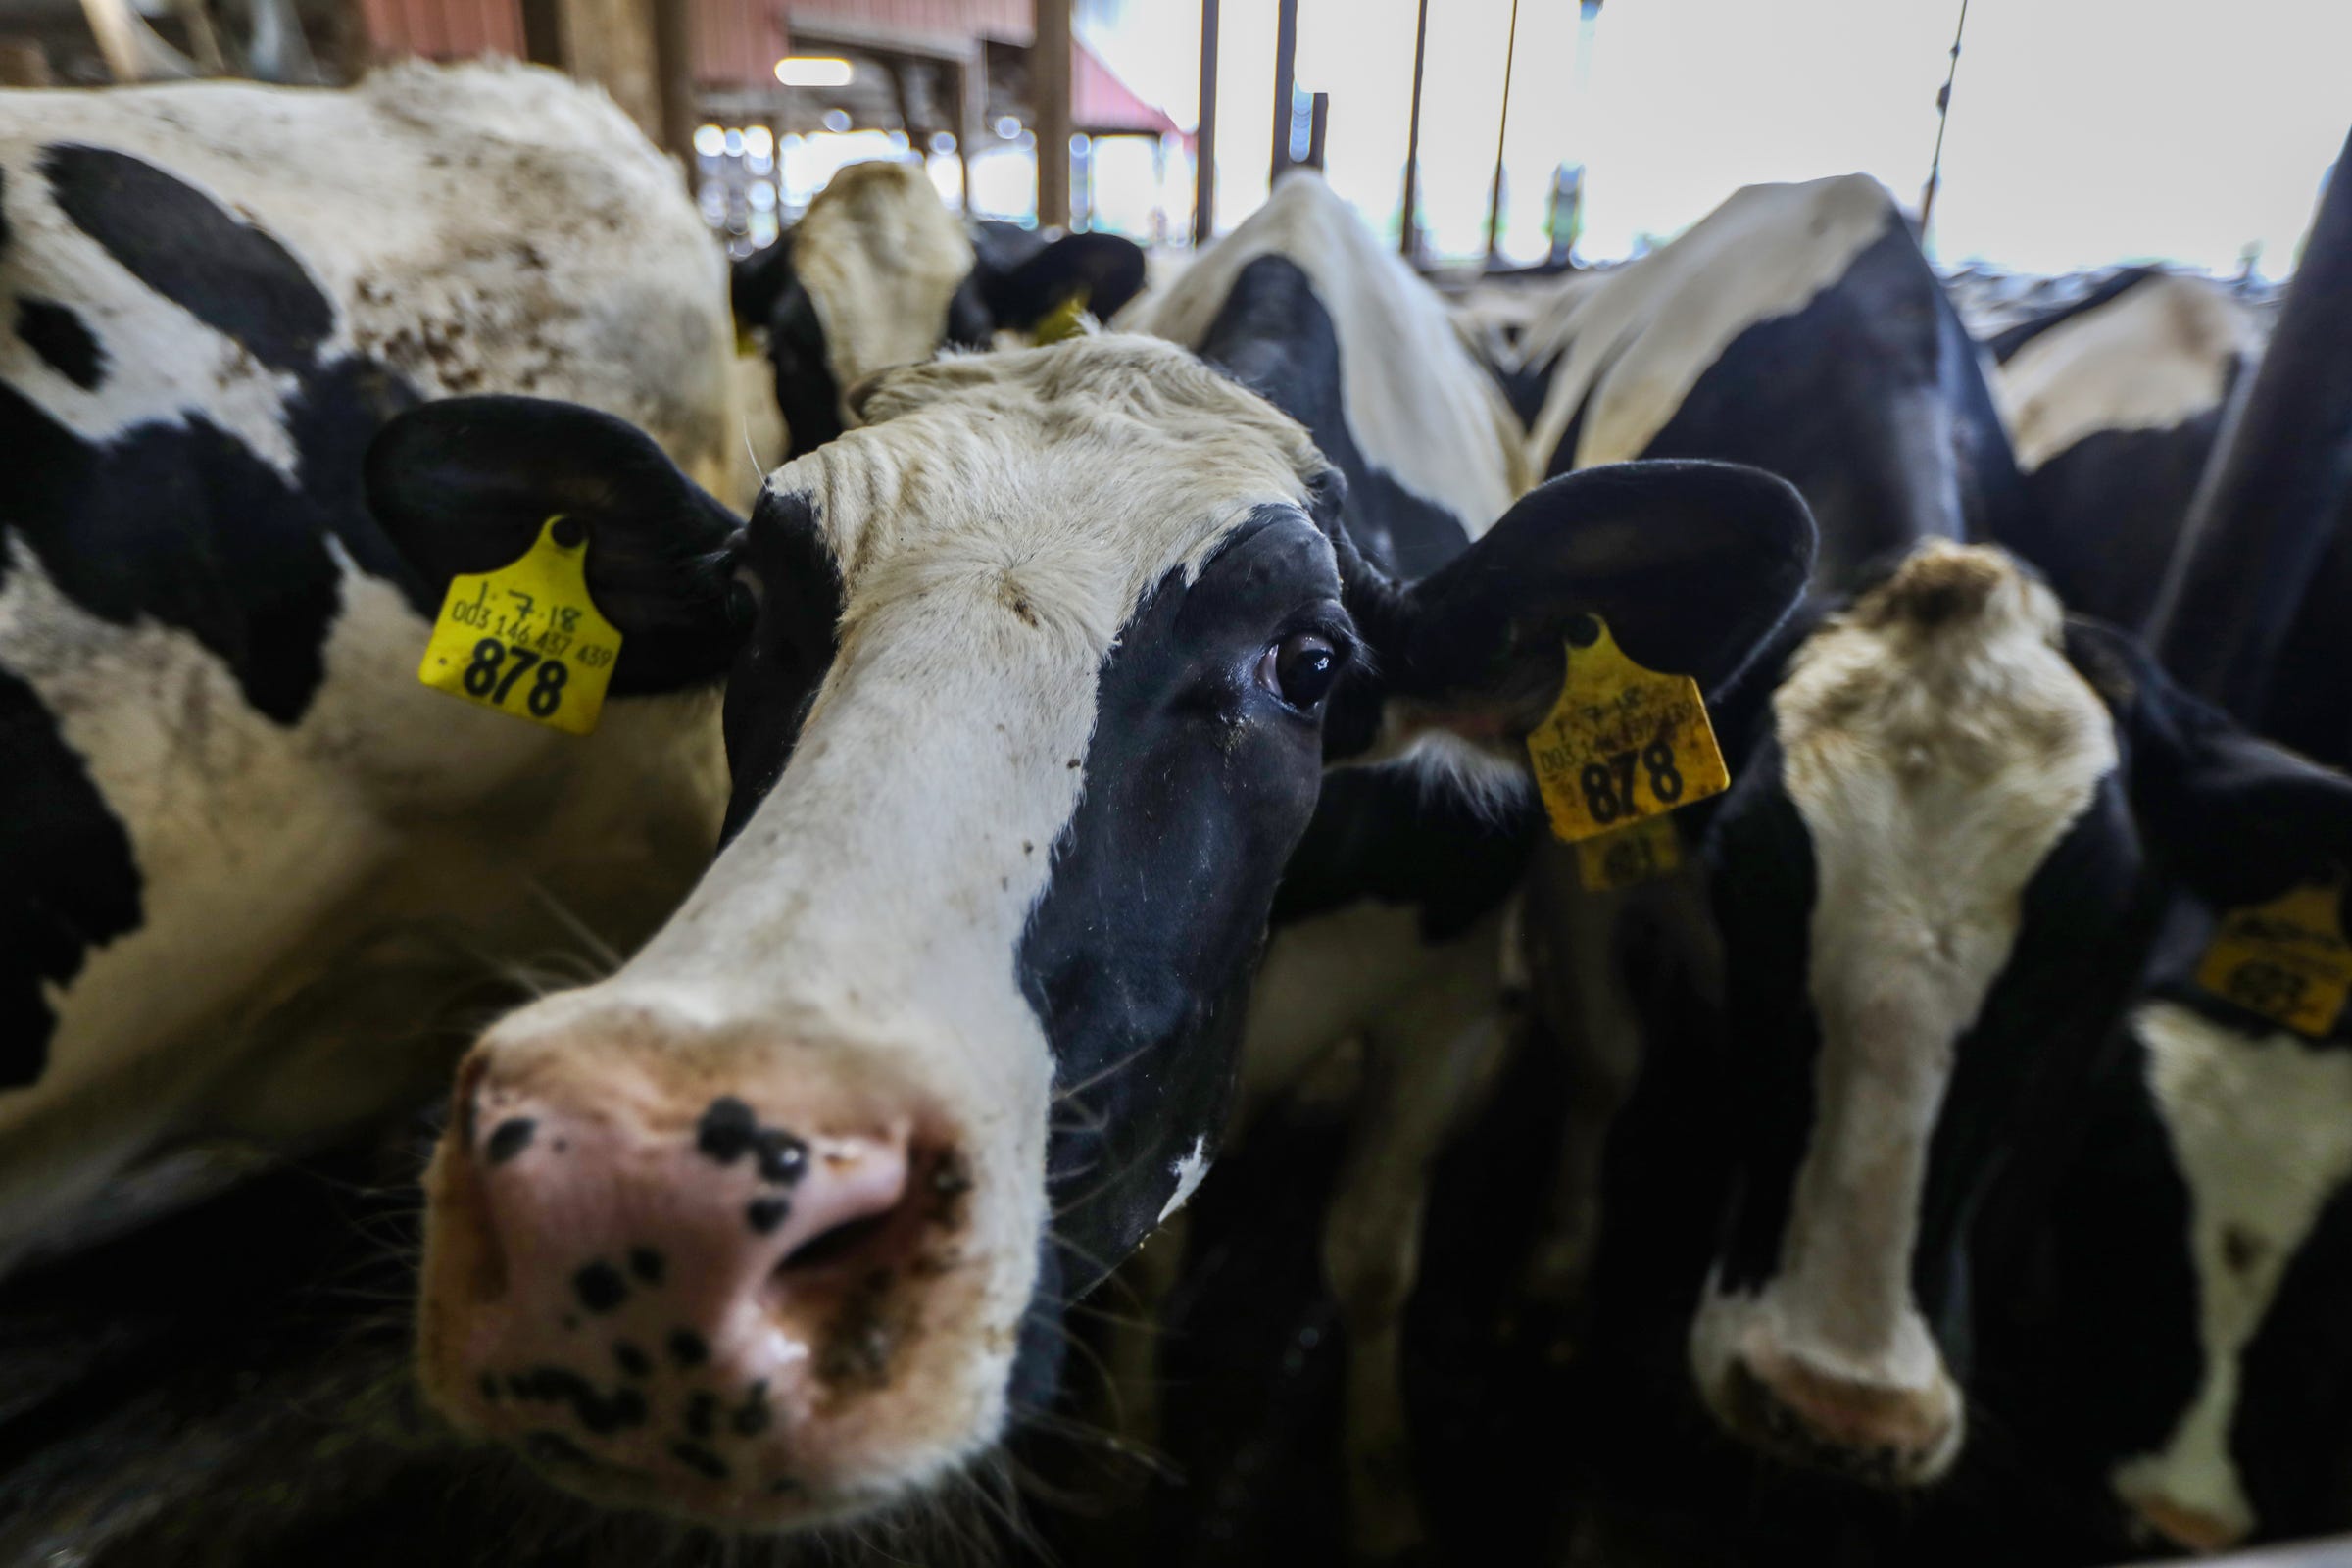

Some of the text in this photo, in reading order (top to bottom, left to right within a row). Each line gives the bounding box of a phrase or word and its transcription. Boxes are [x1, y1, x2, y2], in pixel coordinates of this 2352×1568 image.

[452, 601, 491, 629] 003
[494, 615, 530, 646] 146
[464, 638, 568, 717] 878
[1581, 738, 1683, 824] 878
